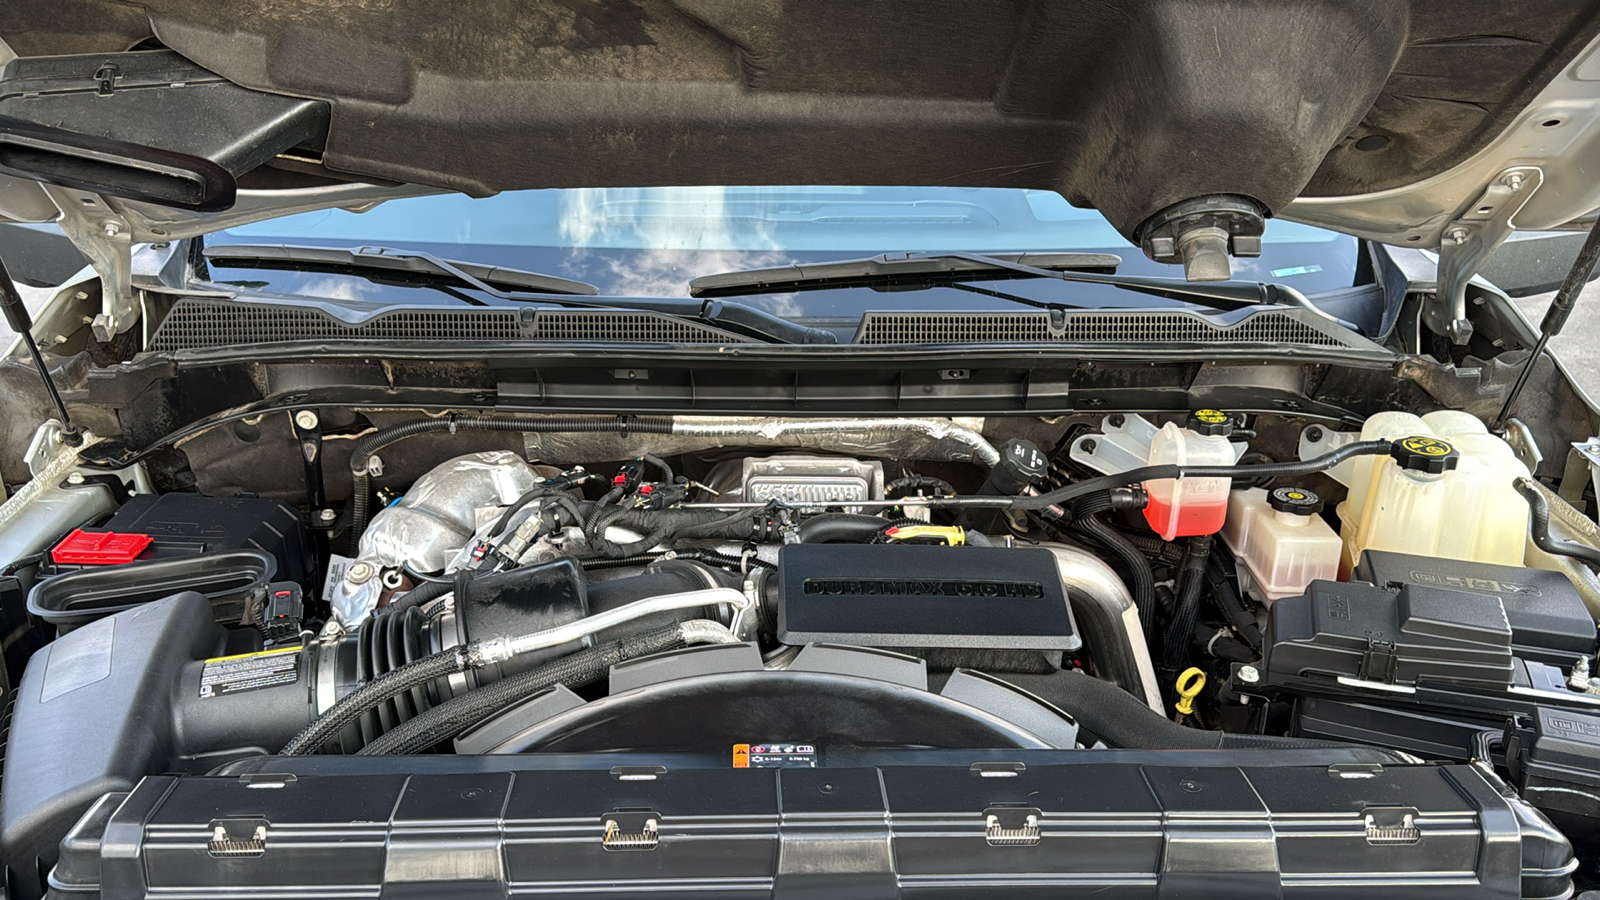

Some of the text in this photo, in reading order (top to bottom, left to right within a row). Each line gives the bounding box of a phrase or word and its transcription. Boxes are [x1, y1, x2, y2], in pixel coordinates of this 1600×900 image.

[808, 580, 1041, 599] DURAMAX 6.6 HD
